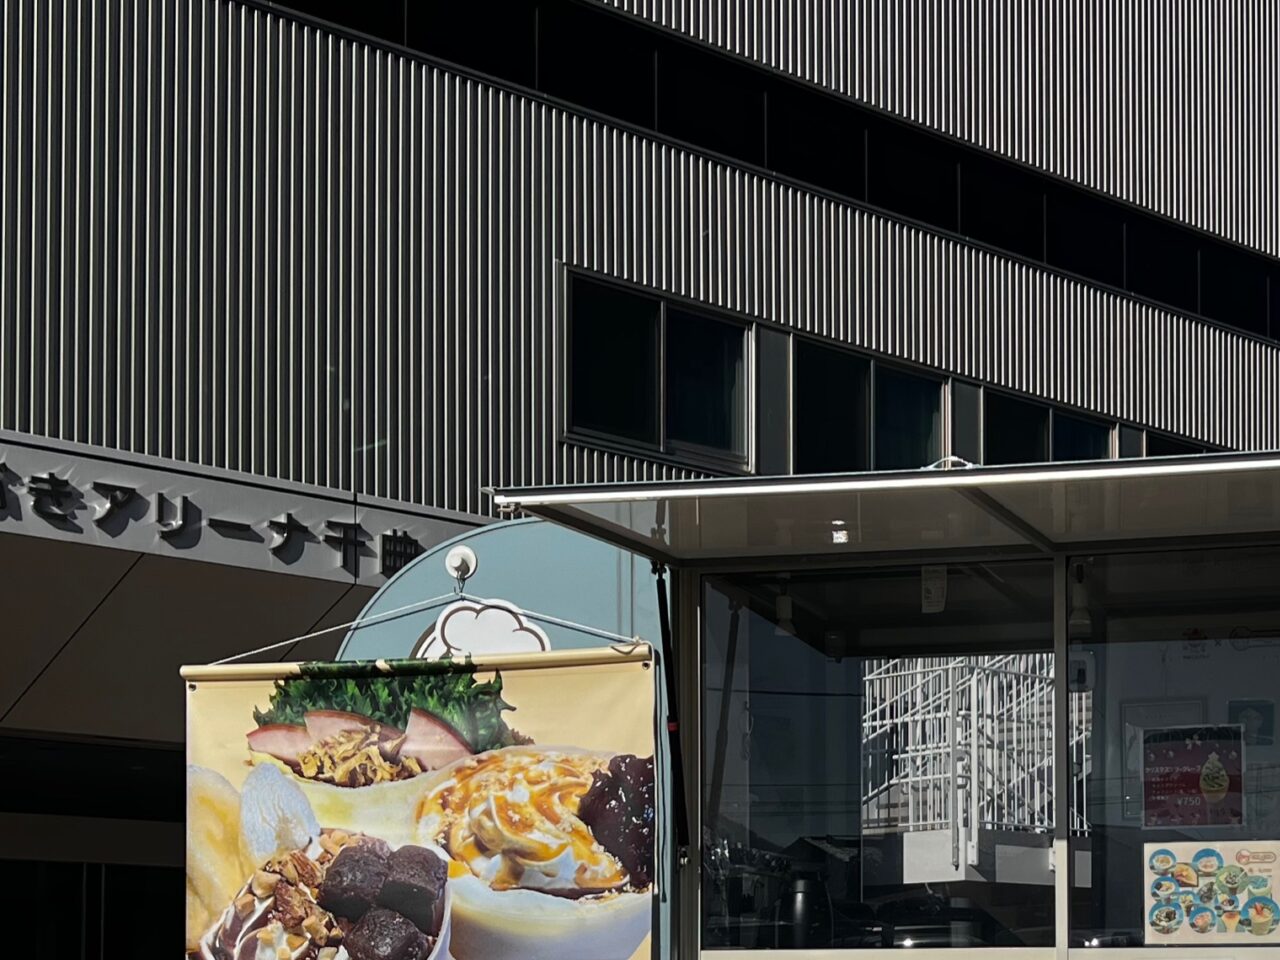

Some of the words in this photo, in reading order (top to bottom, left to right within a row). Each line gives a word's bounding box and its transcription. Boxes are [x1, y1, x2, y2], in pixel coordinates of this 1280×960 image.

[0, 463, 420, 580] きアリーナ千曲
[1177, 796, 1201, 806] ¥750
